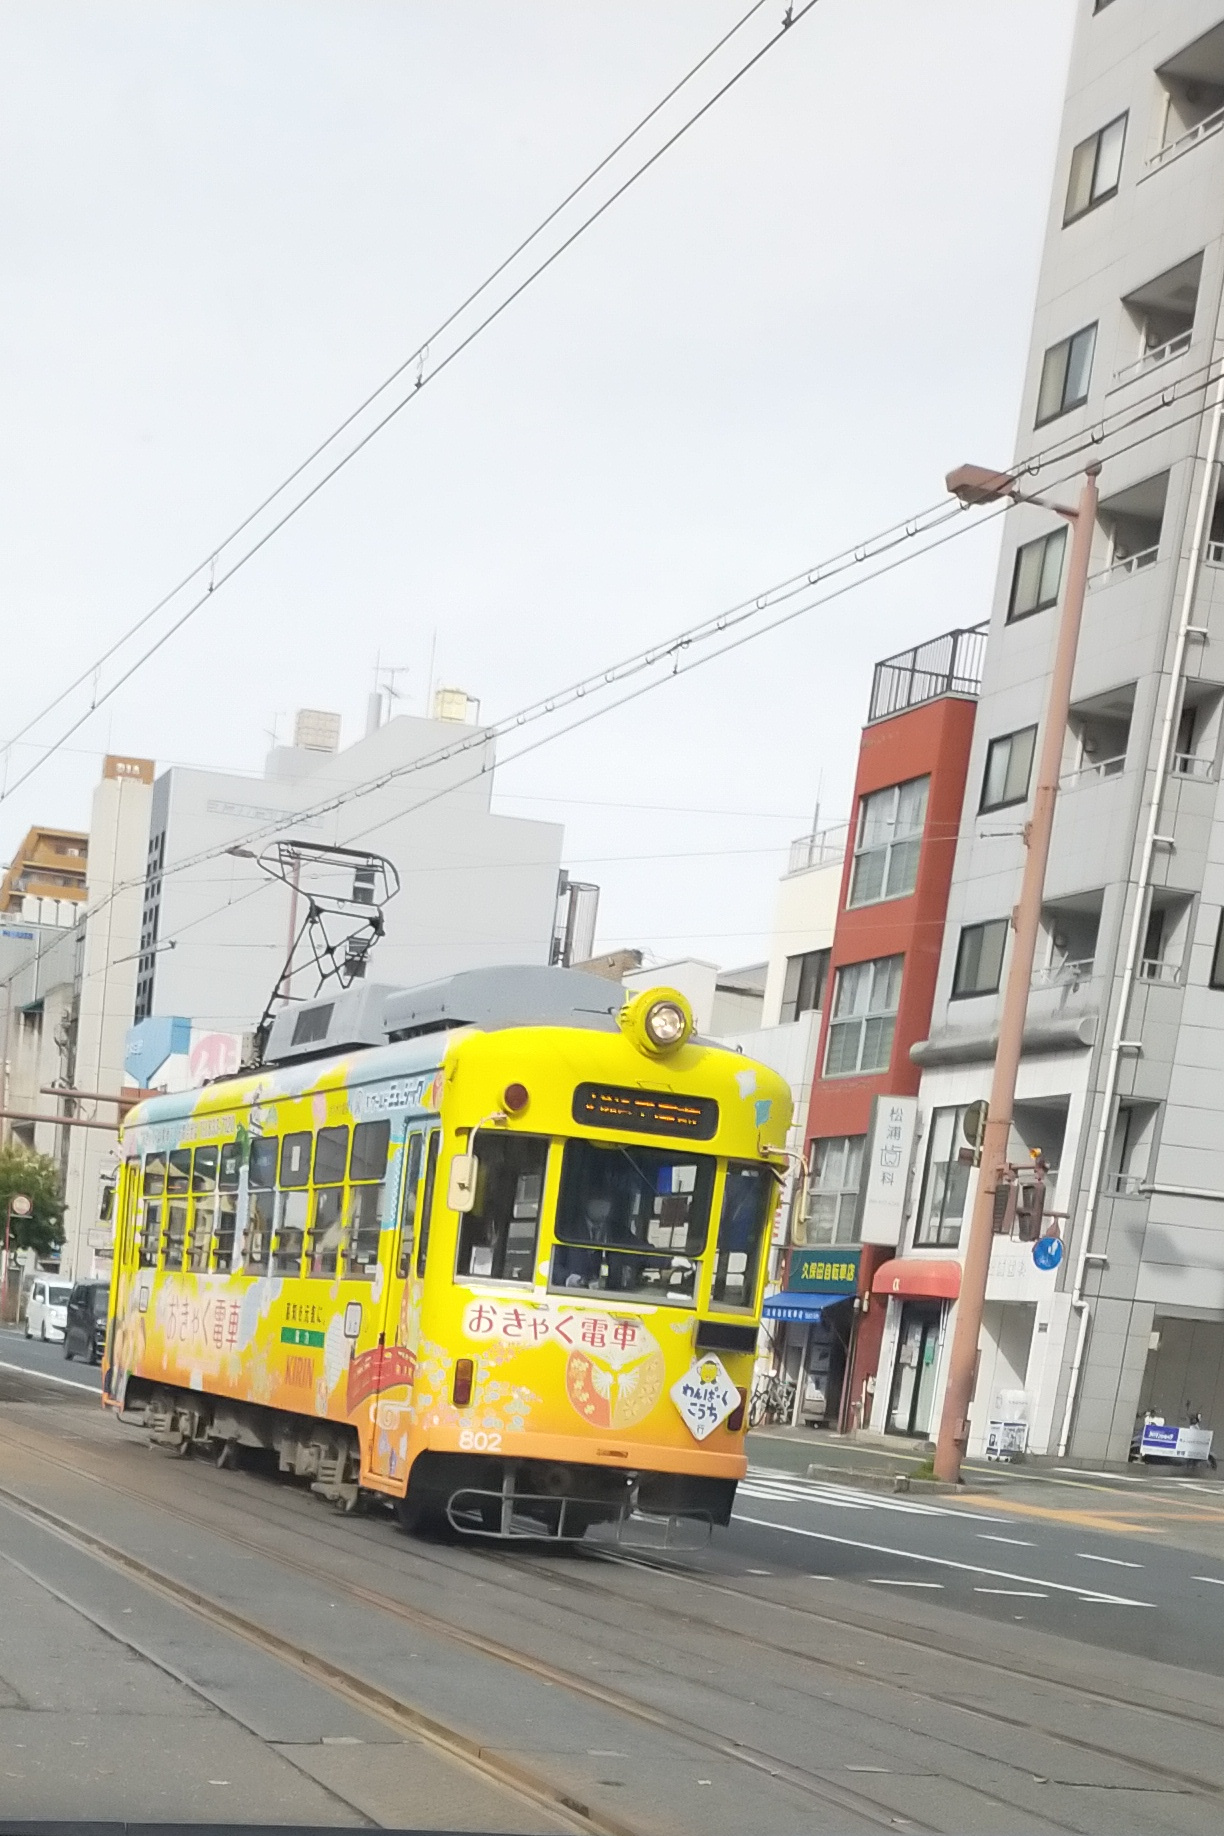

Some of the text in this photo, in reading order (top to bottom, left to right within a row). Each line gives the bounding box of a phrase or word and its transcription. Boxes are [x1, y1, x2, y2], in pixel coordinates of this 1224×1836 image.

[880, 1106, 904, 1186] 松浦歯科
[468, 1304, 639, 1351] おきゃく電車
[687, 1402, 718, 1424] こうち
[458, 1429, 502, 1451] 802
